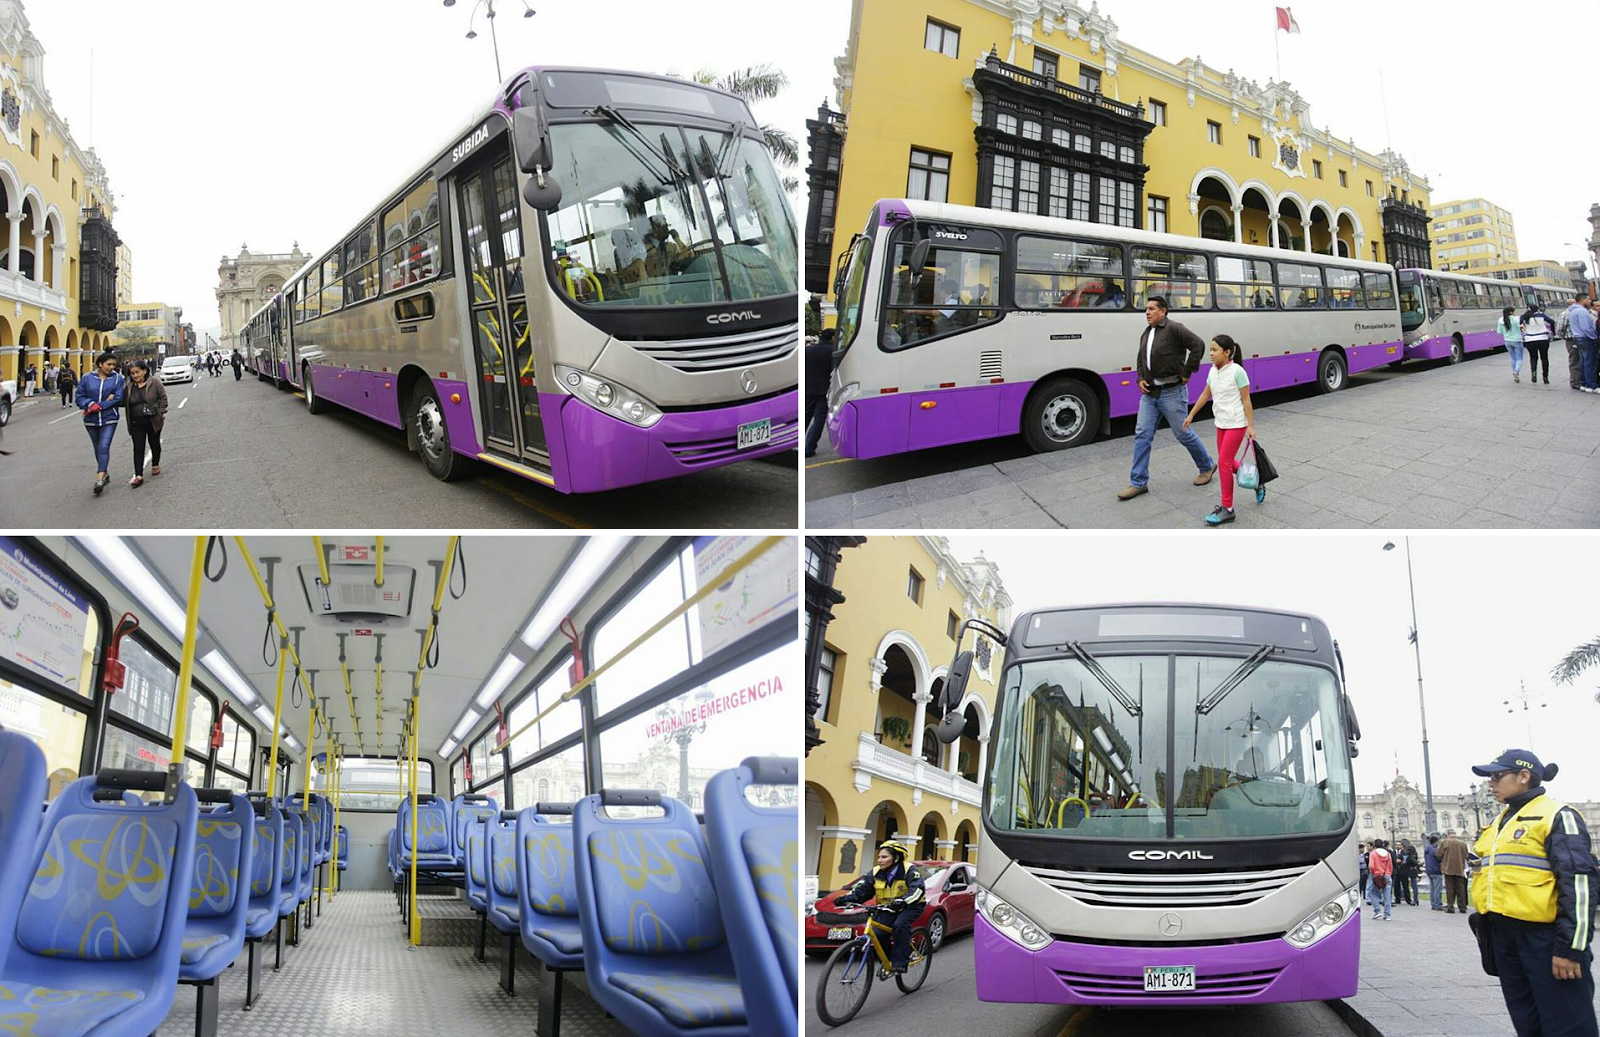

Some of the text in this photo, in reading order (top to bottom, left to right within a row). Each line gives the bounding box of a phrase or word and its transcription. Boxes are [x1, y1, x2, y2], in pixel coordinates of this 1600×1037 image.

[452, 124, 489, 163] SUBIDA
[935, 231, 967, 240] SVELTO
[706, 310, 761, 324] COMIL
[740, 425, 770, 445] AMI-871
[646, 676, 783, 738] VENTANA DE EMERGENCIA
[1515, 759, 1534, 769] GTU
[1128, 850, 1214, 861] COMIL
[1146, 973, 1193, 988] AMI-871
